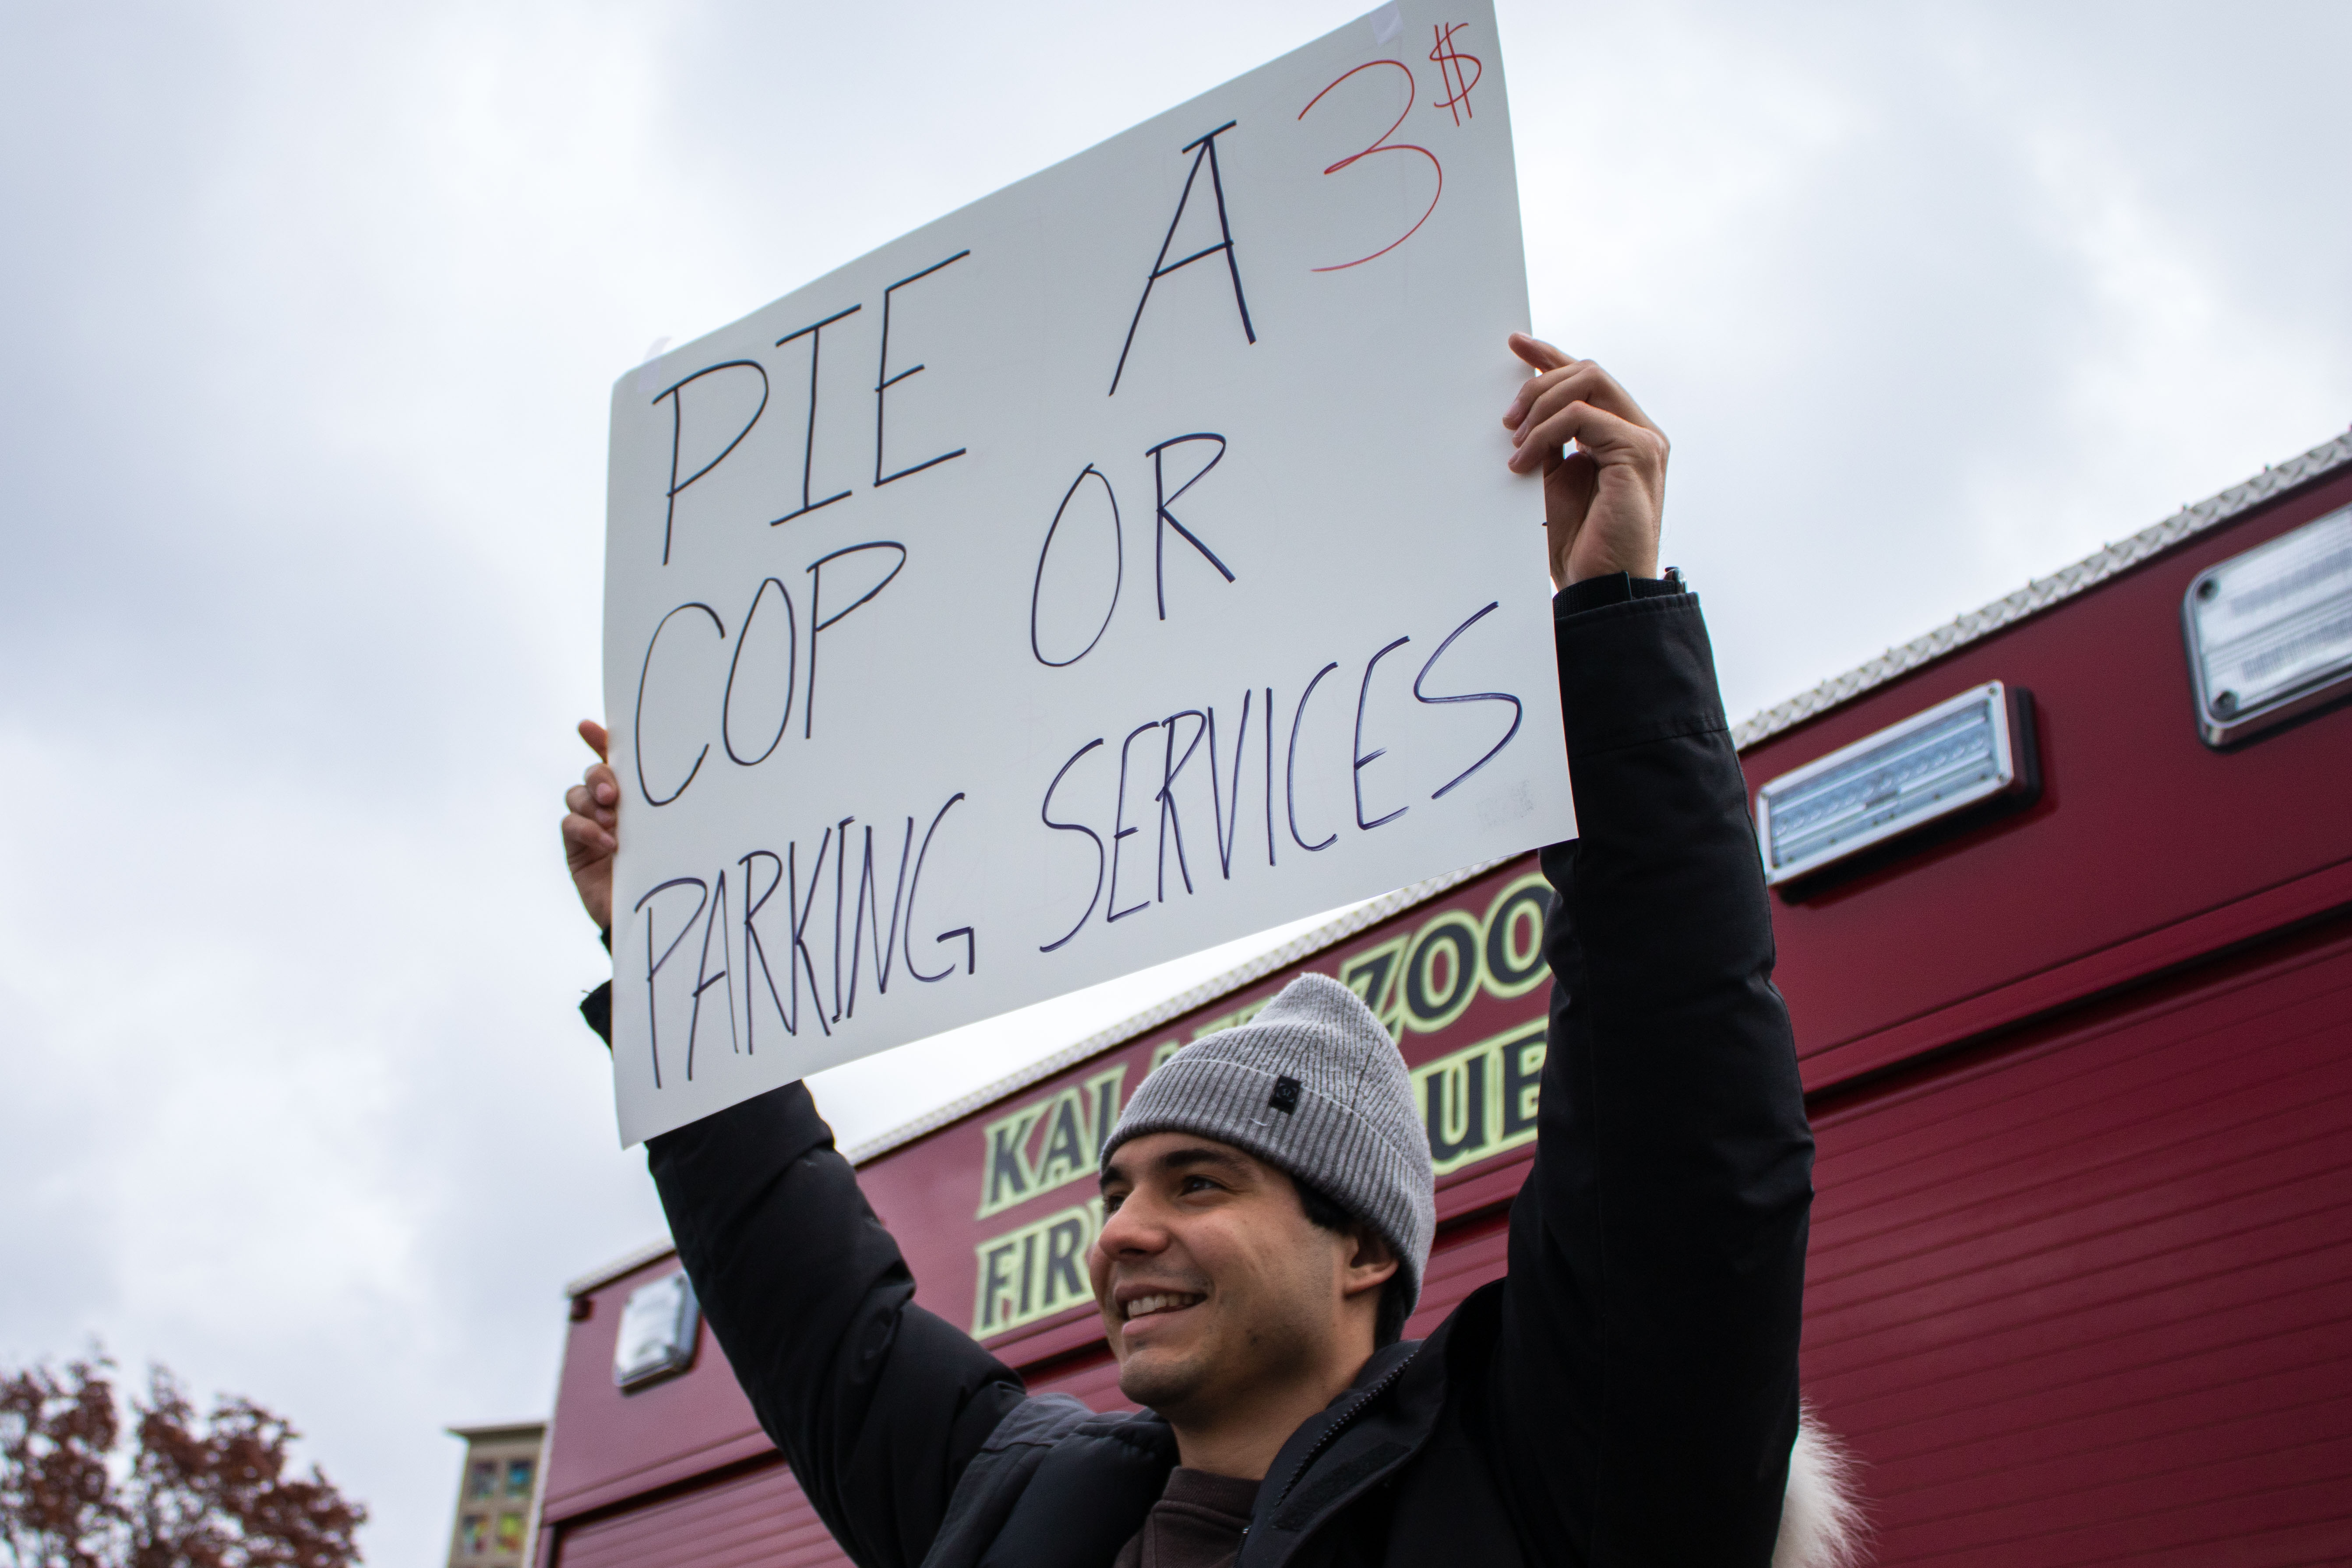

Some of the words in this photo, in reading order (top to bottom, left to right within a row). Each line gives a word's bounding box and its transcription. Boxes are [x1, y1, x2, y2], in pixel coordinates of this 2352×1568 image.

[652, 250, 971, 566] PIE
[1109, 120, 1256, 396] A
[636, 541, 906, 807] COP
[1031, 433, 1236, 667] OR
[635, 793, 975, 1089] PARKING
[1038, 601, 1523, 953] SERVICES
[969, 1194, 1104, 1341] FIR
